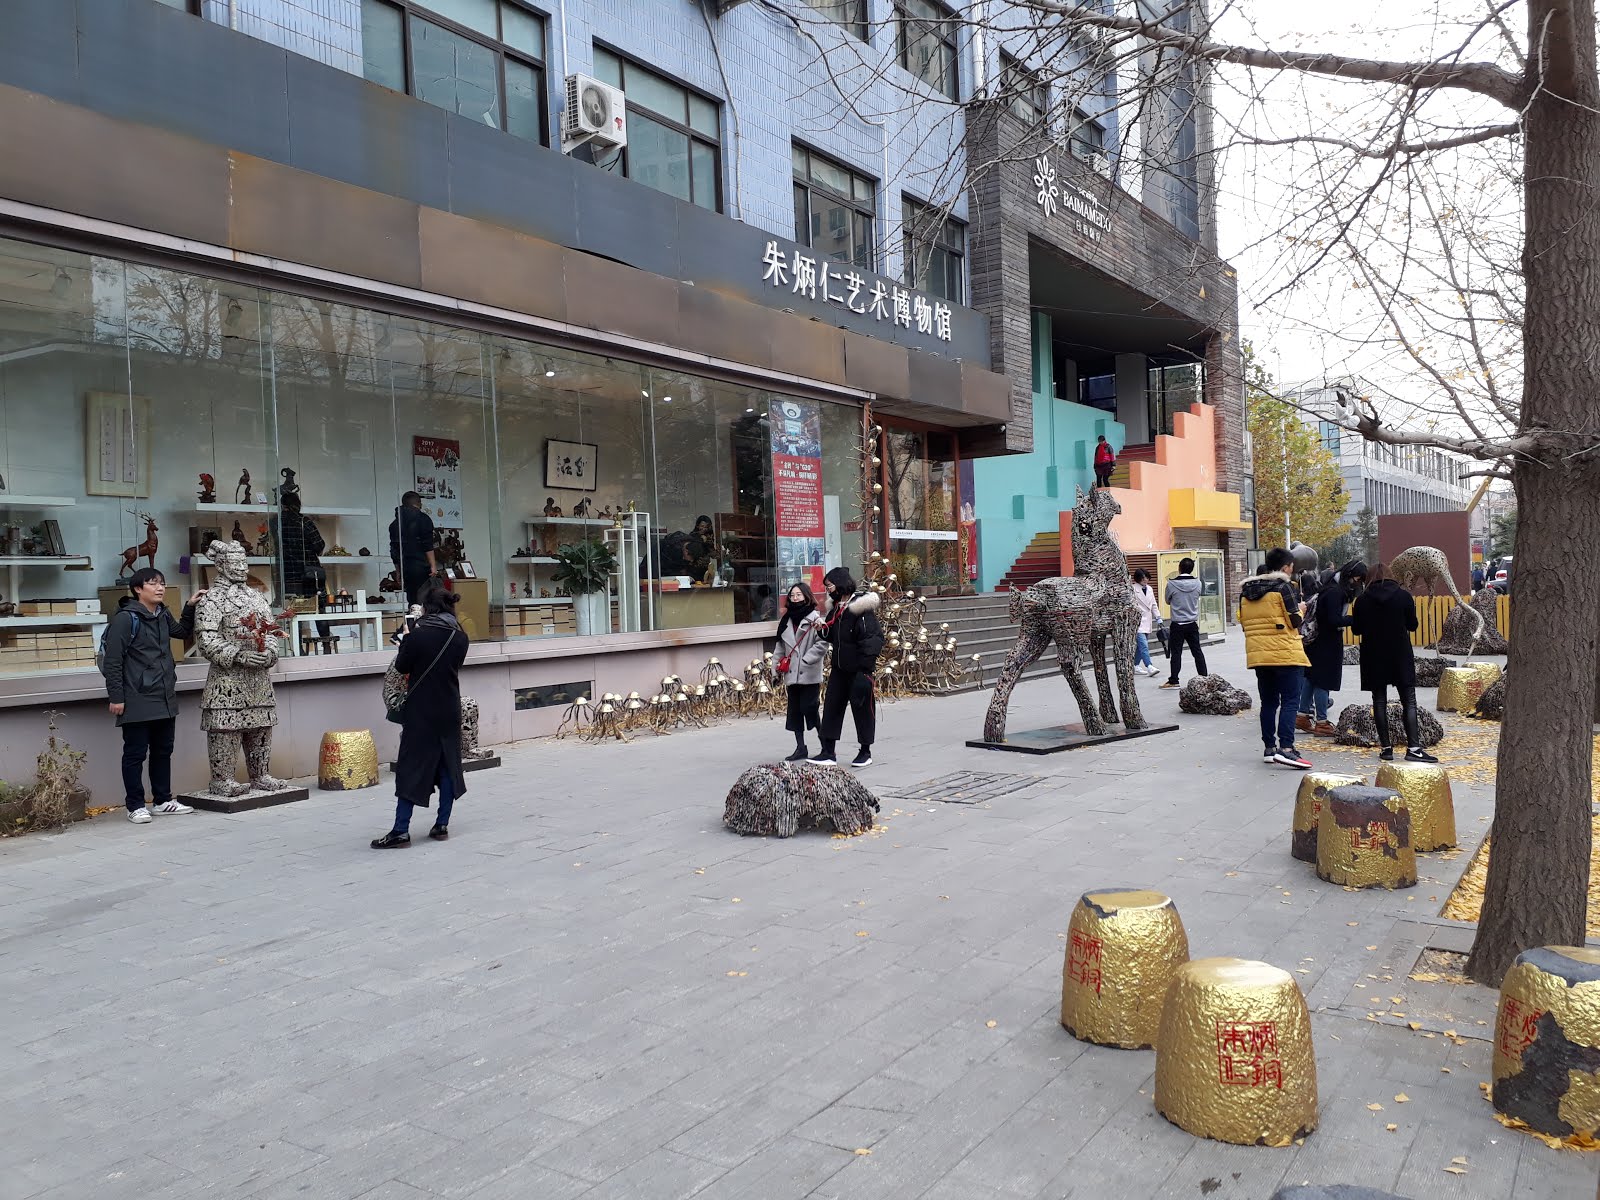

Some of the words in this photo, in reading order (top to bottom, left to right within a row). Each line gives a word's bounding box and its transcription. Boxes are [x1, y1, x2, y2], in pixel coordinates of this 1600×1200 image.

[762, 241, 952, 341] 朱炳仁艺术博物馆
